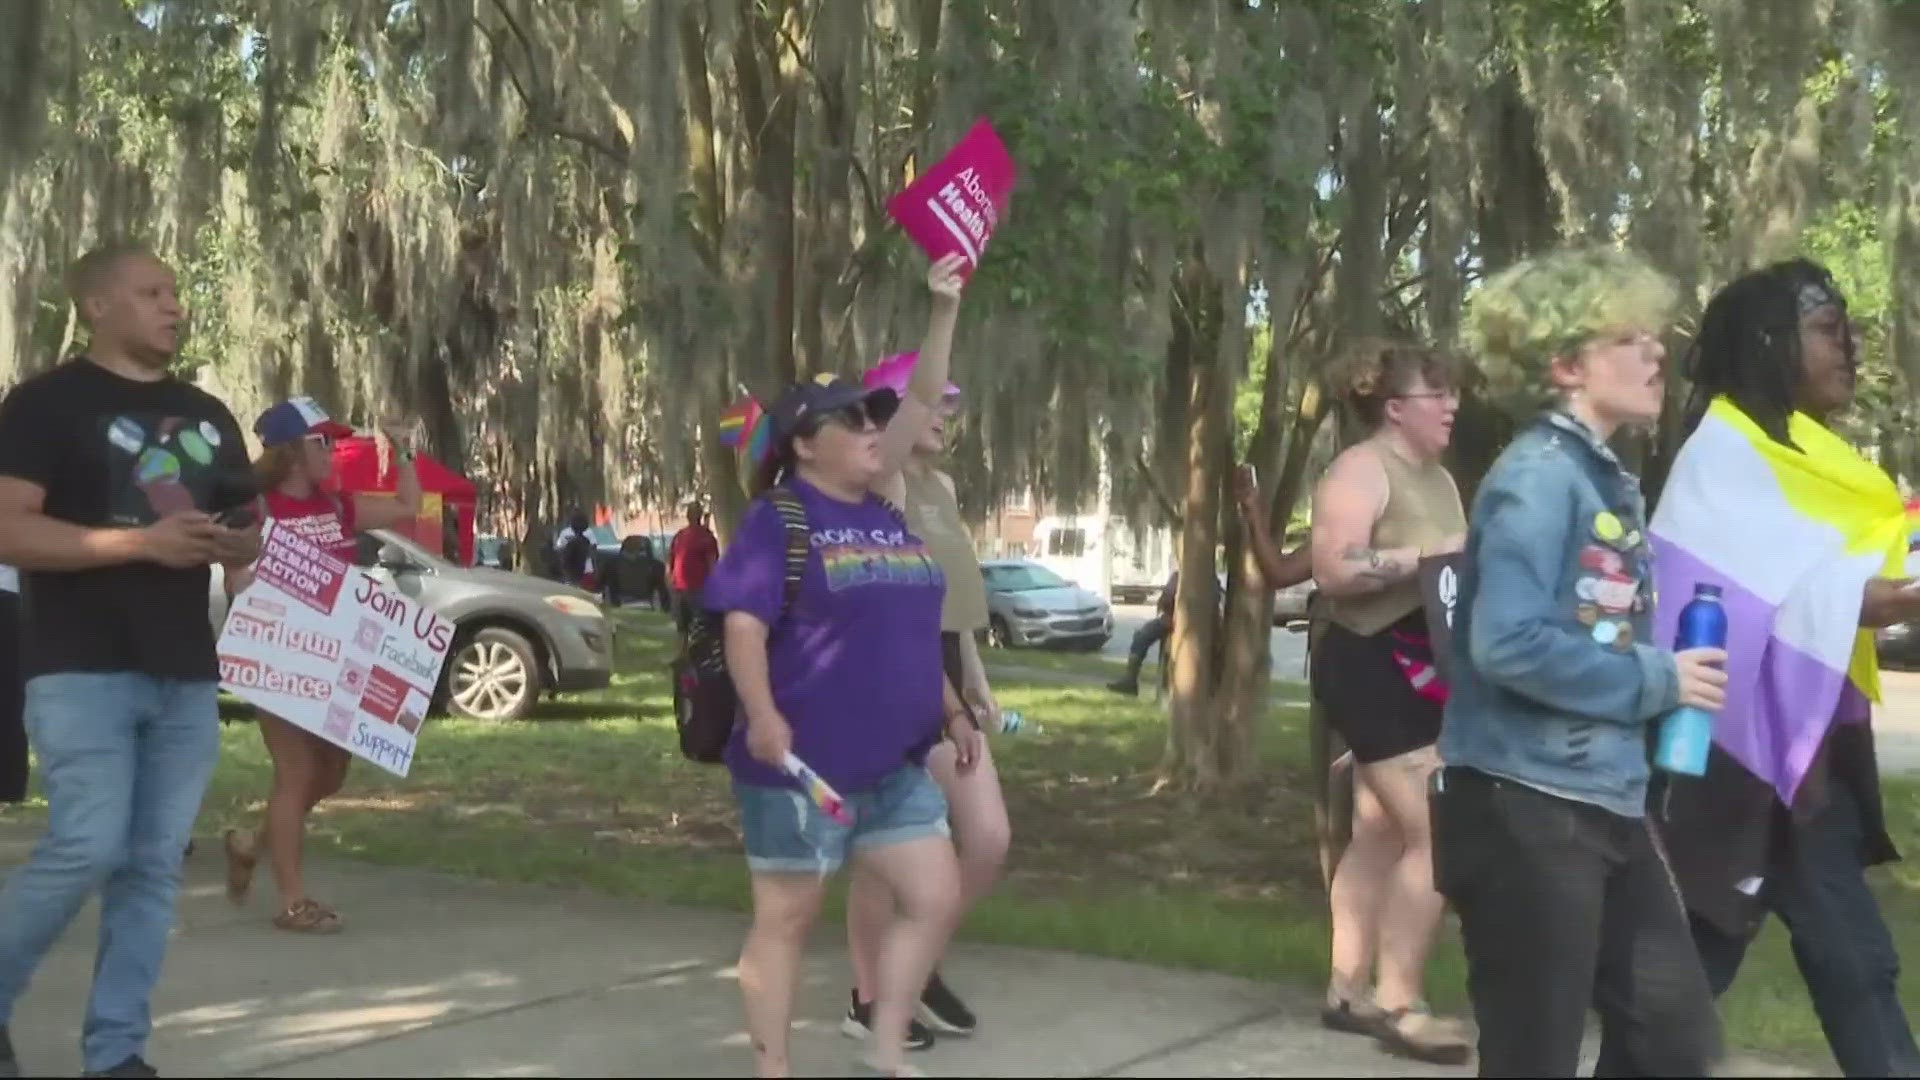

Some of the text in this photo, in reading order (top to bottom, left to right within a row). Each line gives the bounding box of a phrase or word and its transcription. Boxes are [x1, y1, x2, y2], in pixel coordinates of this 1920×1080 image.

[267, 540, 332, 585] DEMAND
[272, 524, 320, 560] MOMS
[259, 555, 320, 595] ACTION
[355, 572, 406, 627] Join
[231, 614, 341, 663] end gun
[219, 656, 332, 700] violence
[353, 722, 411, 770] Support
